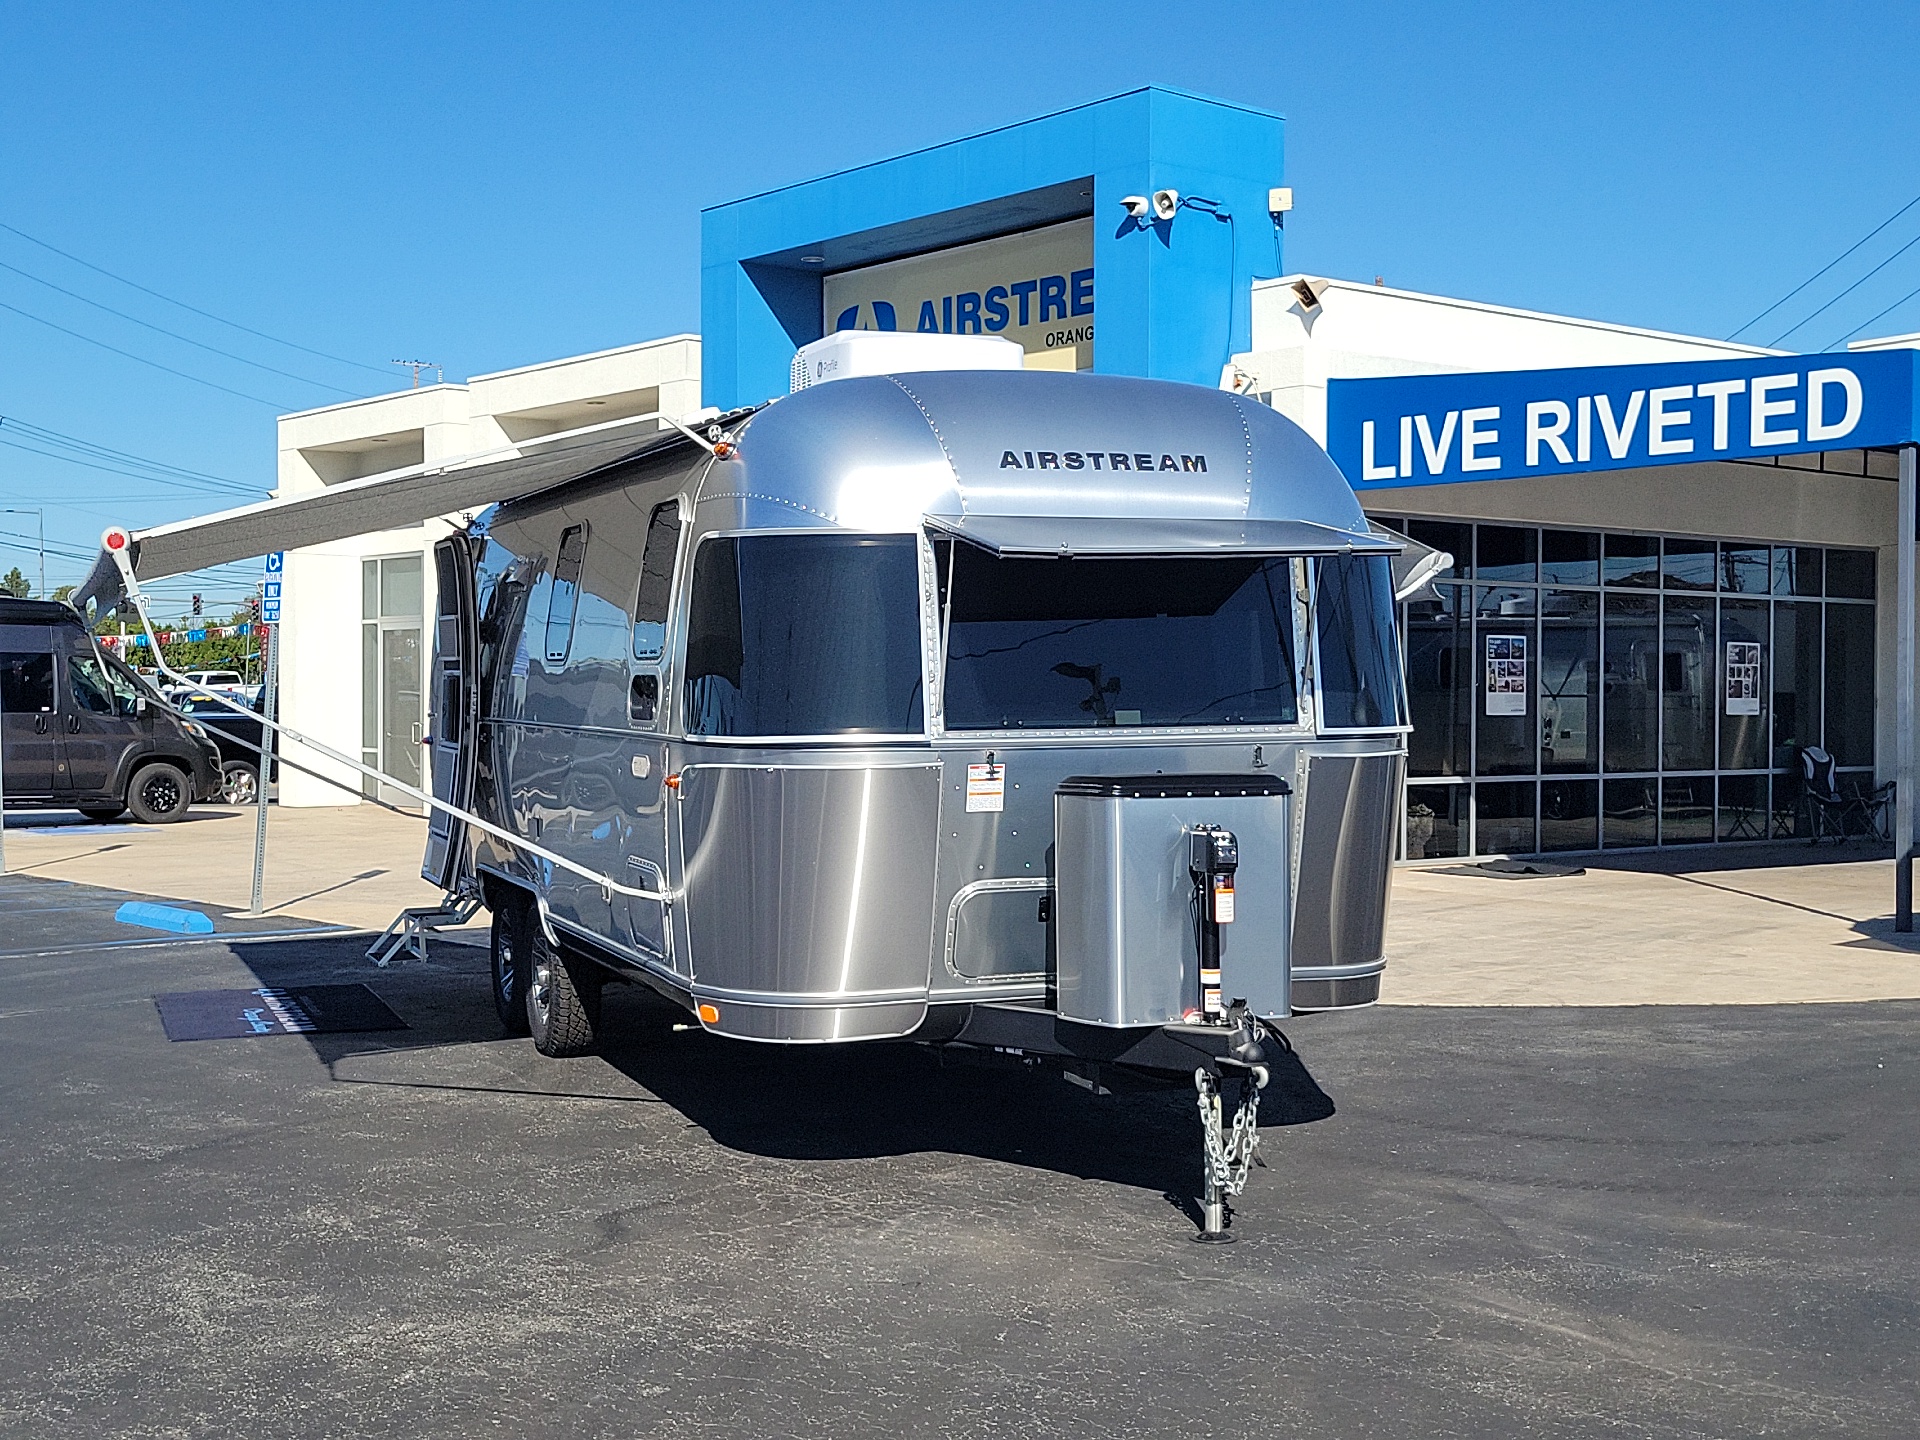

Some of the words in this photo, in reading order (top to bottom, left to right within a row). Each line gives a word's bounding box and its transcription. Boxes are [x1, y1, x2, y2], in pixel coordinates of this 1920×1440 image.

[1362, 406, 1501, 480] LIVE
[1526, 367, 1863, 466] RIVETED
[1000, 451, 1208, 473] AIRSTREAM
